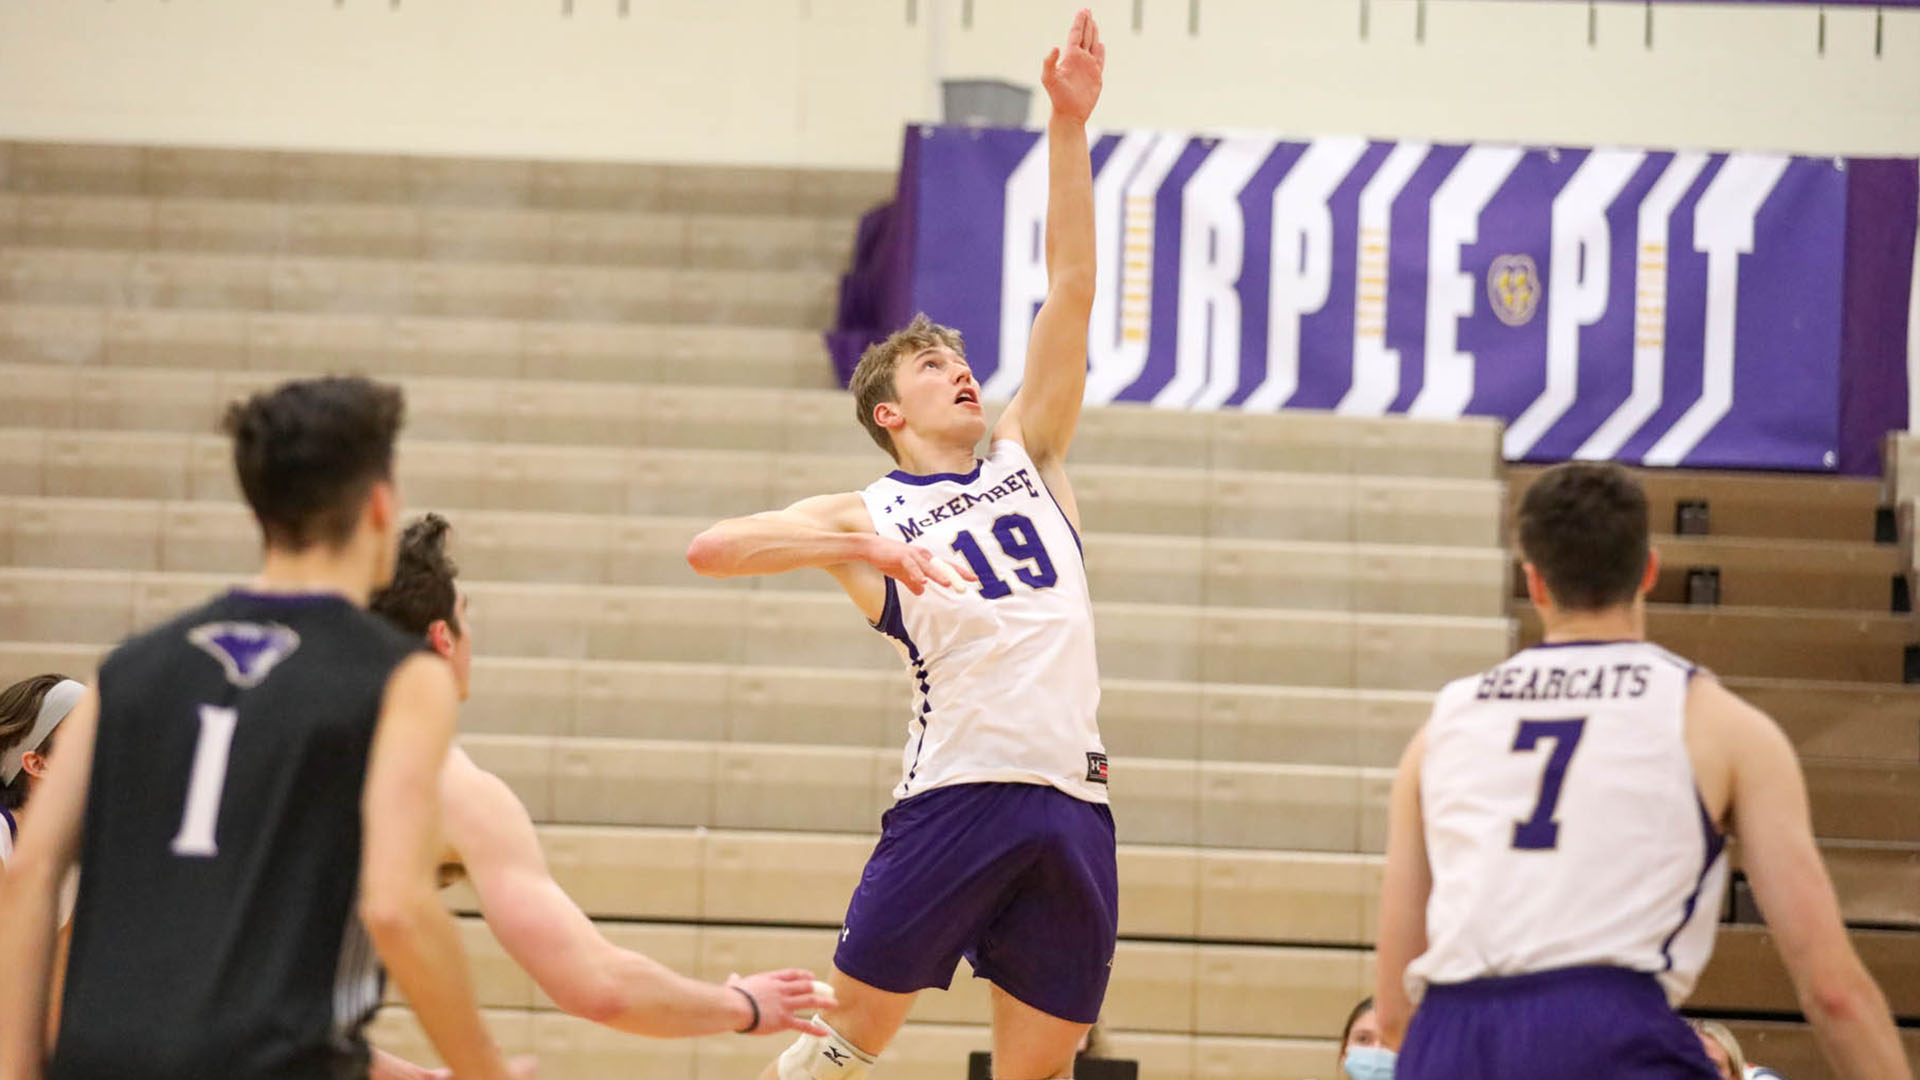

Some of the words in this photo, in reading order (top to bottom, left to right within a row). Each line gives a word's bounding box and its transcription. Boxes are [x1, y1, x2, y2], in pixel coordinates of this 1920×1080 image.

[992, 150, 1495, 410] PURPLE
[1520, 165, 1775, 440] PIT
[950, 512, 1059, 600] 19
[1476, 664, 1651, 700] BEARCATS
[170, 704, 238, 857] 1
[1512, 716, 1587, 850] 7
